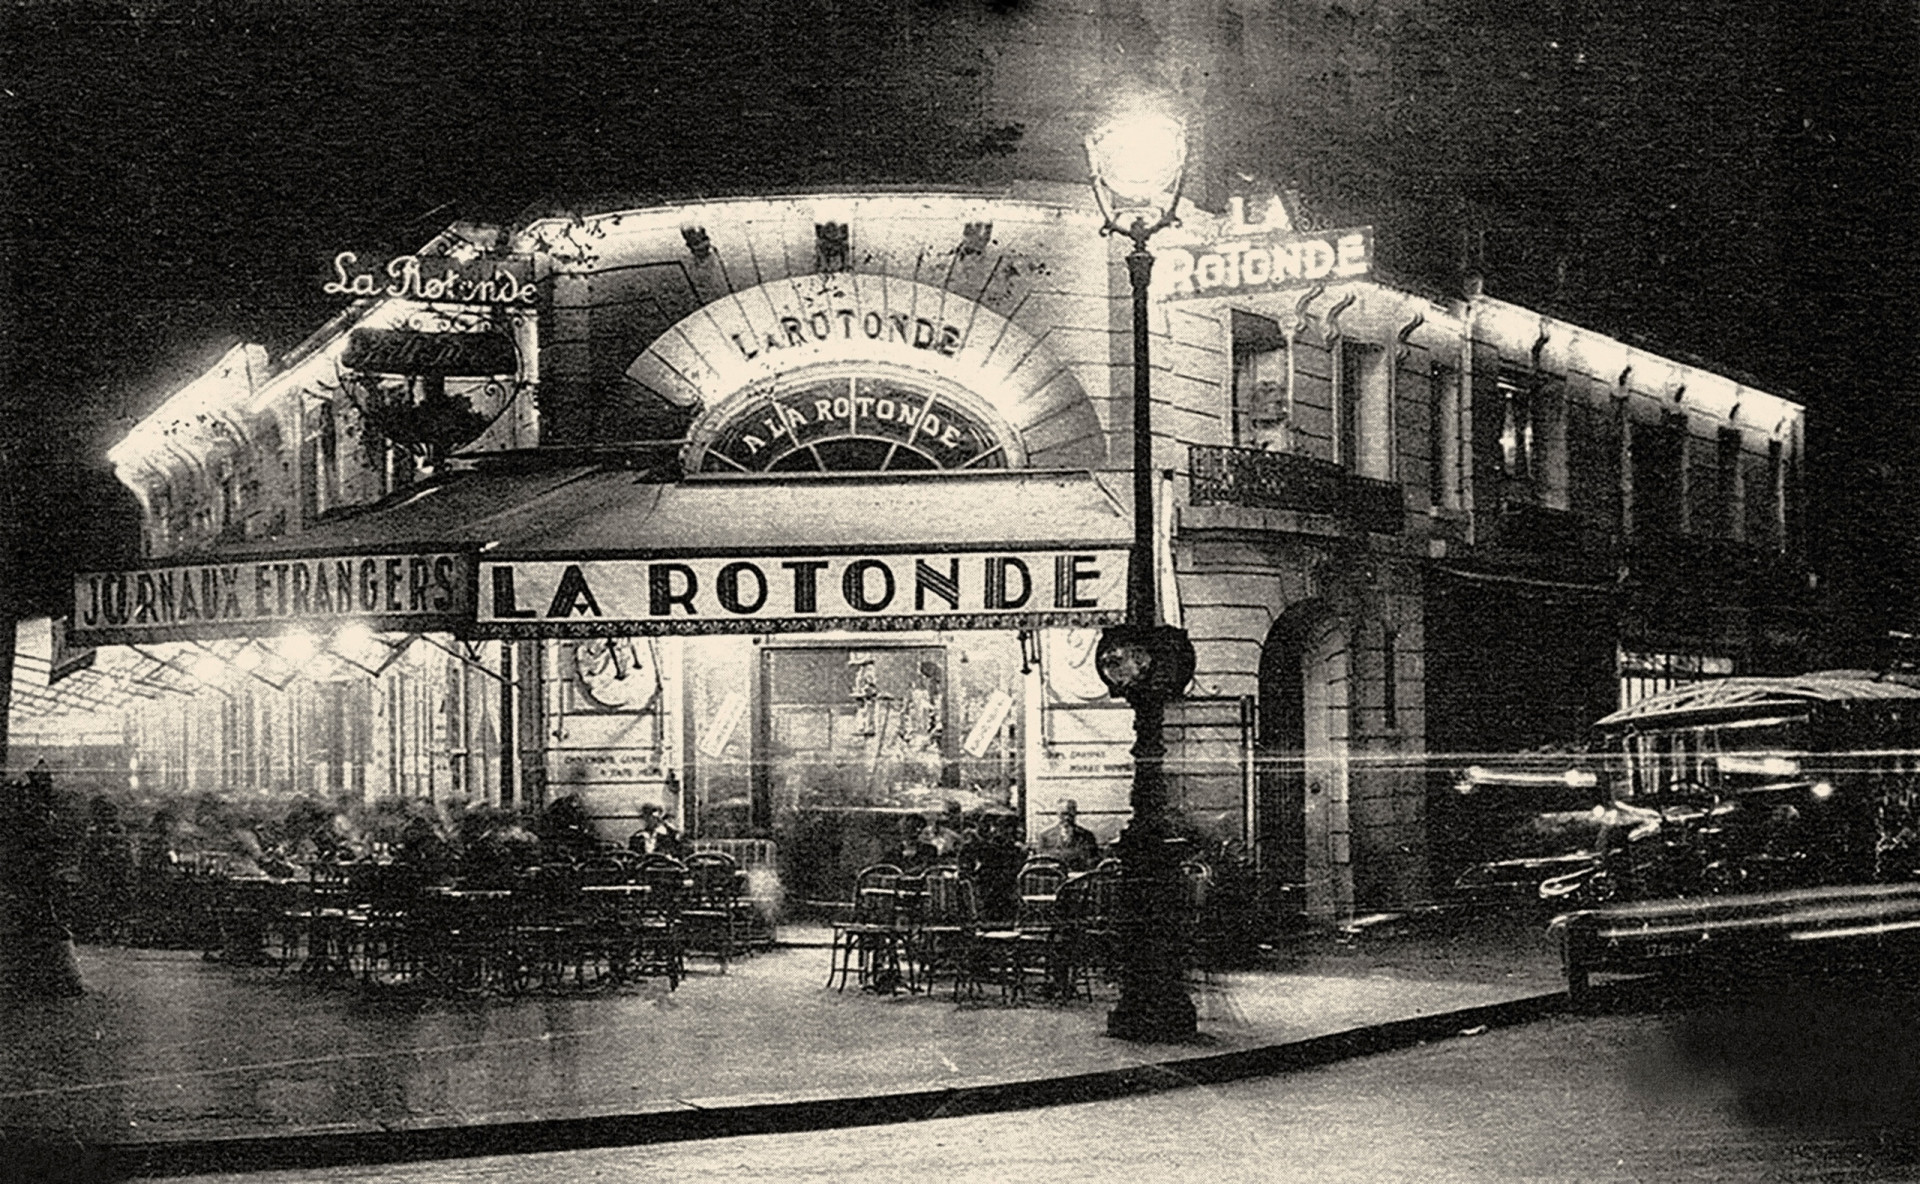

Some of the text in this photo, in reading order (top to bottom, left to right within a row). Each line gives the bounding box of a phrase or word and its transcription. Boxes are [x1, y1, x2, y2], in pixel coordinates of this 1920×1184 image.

[1228, 194, 1294, 233] LA
[324, 251, 382, 295] La
[1152, 234, 1368, 293] ROTONDE
[743, 397, 961, 454] A LA ROTONDE
[254, 555, 454, 618] ETRANGERS
[491, 555, 1101, 619] LA ROTONDE
